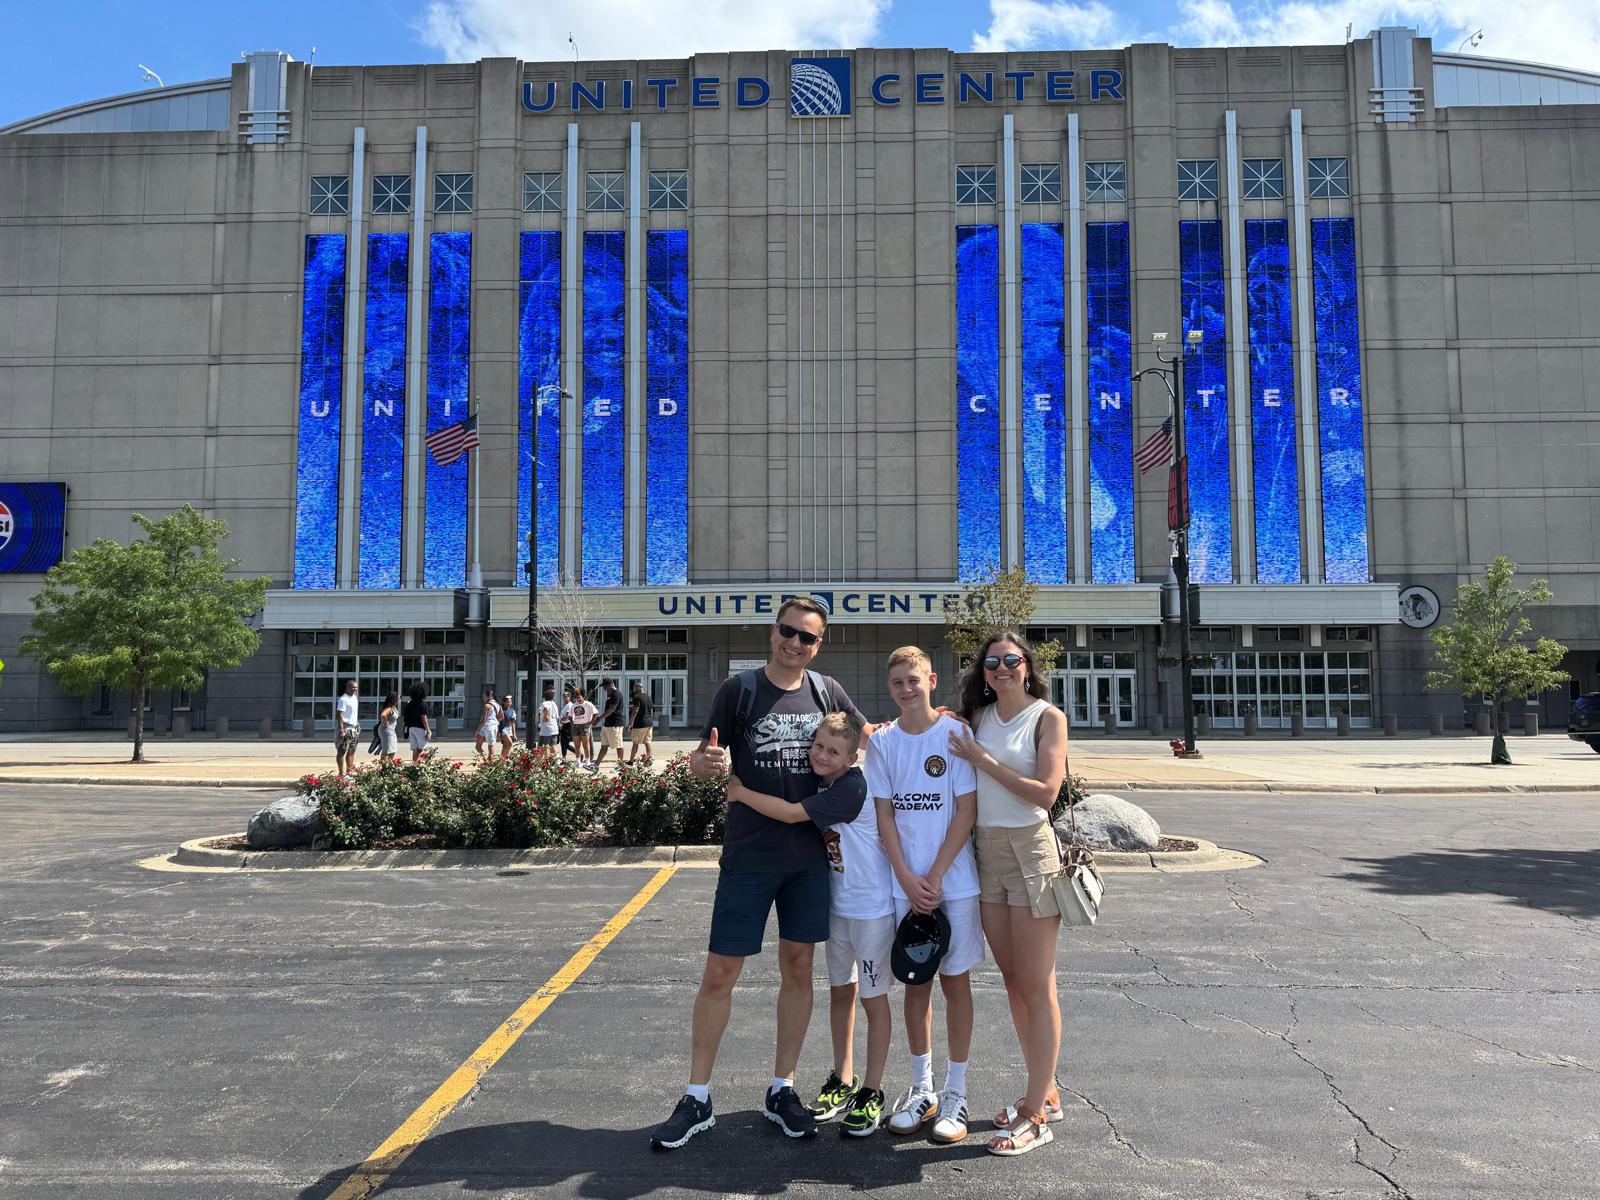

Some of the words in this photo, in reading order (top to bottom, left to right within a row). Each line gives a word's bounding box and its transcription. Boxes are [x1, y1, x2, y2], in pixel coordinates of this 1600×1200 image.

[522, 76, 770, 112] UNITED
[871, 69, 1125, 105] CENTER
[892, 792, 941, 801] ALCONS
[891, 802, 943, 811] CADEMY
[862, 960, 878, 987] NY
